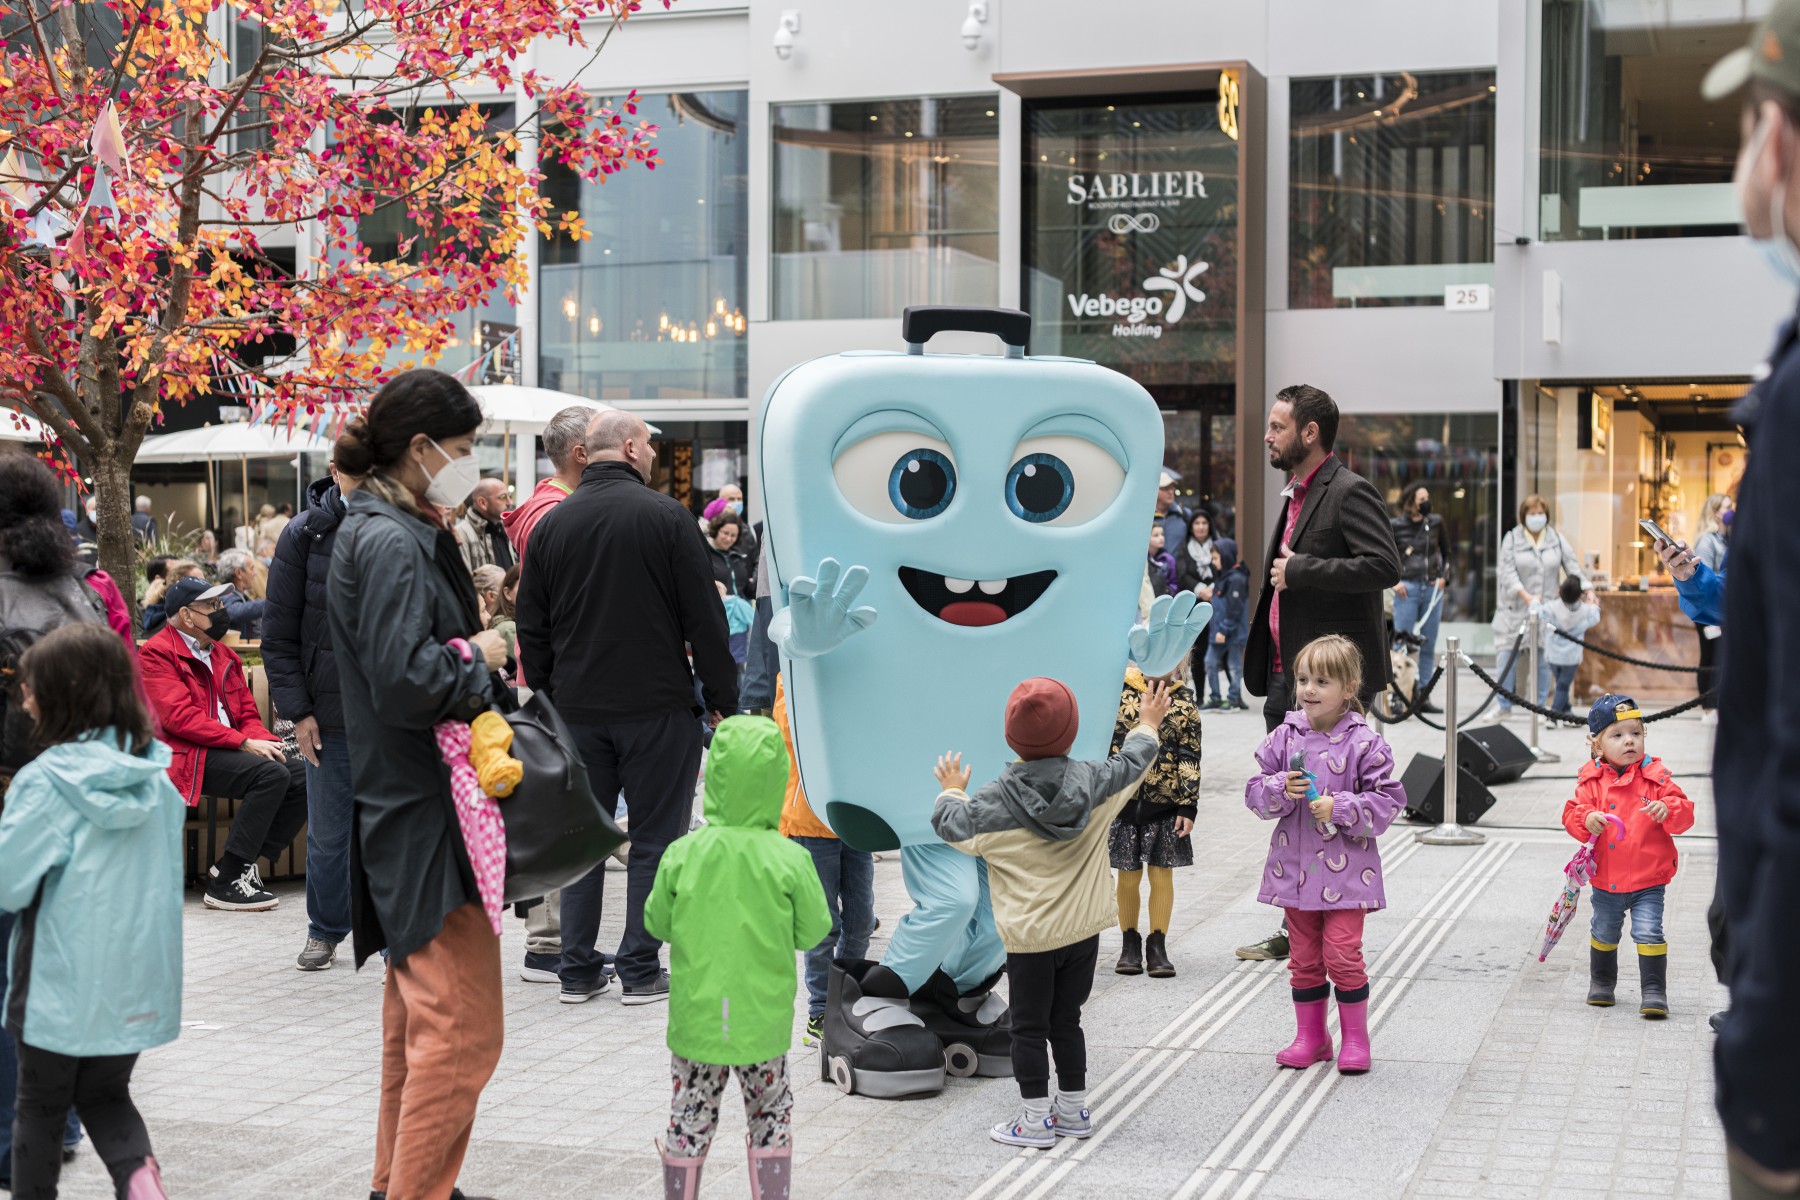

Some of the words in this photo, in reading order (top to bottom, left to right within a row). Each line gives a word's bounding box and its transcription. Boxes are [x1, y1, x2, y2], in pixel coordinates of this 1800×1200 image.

[1067, 170, 1208, 205] SABLIER
[1456, 289, 1478, 304] 25
[1067, 293, 1163, 323] Vebego
[1112, 324, 1162, 339] Holding
